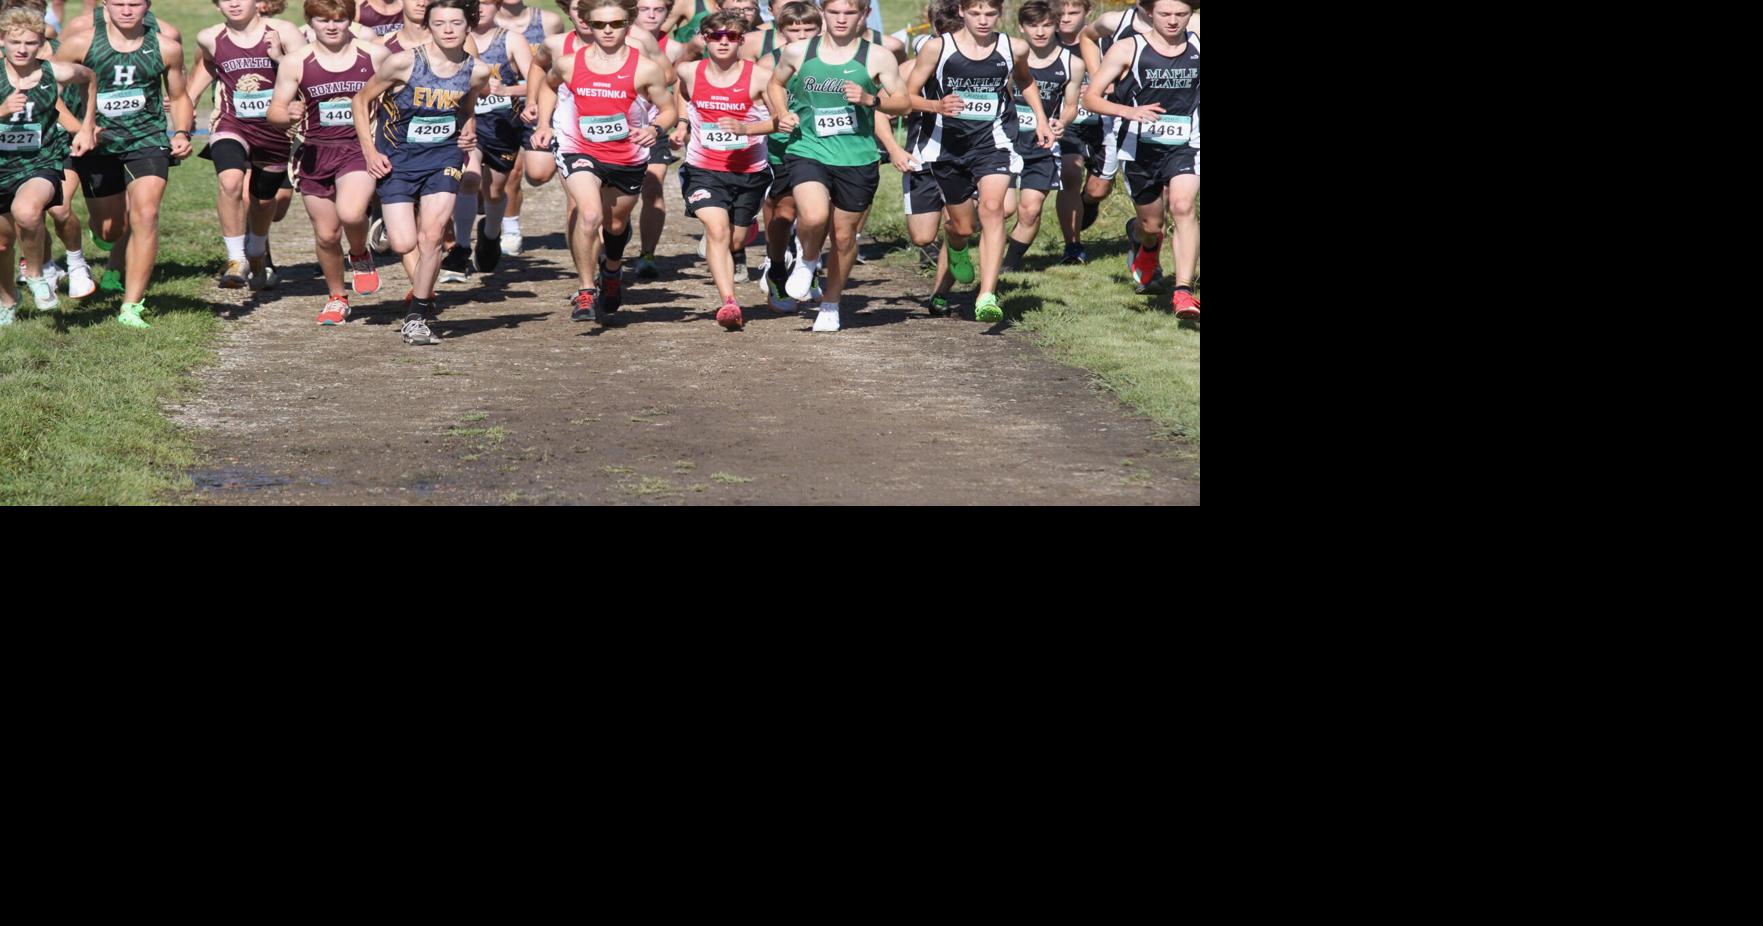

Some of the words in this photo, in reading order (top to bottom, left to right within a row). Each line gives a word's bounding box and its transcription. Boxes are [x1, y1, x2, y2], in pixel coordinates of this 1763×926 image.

[221, 57, 272, 73] ROYALTO
[112, 65, 136, 85] H
[1145, 68, 1198, 79] MAPLE
[947, 77, 1001, 87] MAPLE
[1150, 79, 1192, 88] LAKE
[577, 87, 627, 99] WESTONKA
[104, 99, 140, 110] 4228
[476, 95, 505, 106] 206
[696, 100, 746, 111] WESTONKA
[964, 101, 992, 112] 469
[326, 110, 353, 120] 440
[1018, 114, 1033, 126] 62
[817, 115, 854, 128] 4363
[414, 125, 450, 135] 4205
[587, 123, 623, 135] 4326
[1147, 124, 1184, 137] 4461
[0, 133, 34, 144] 4227
